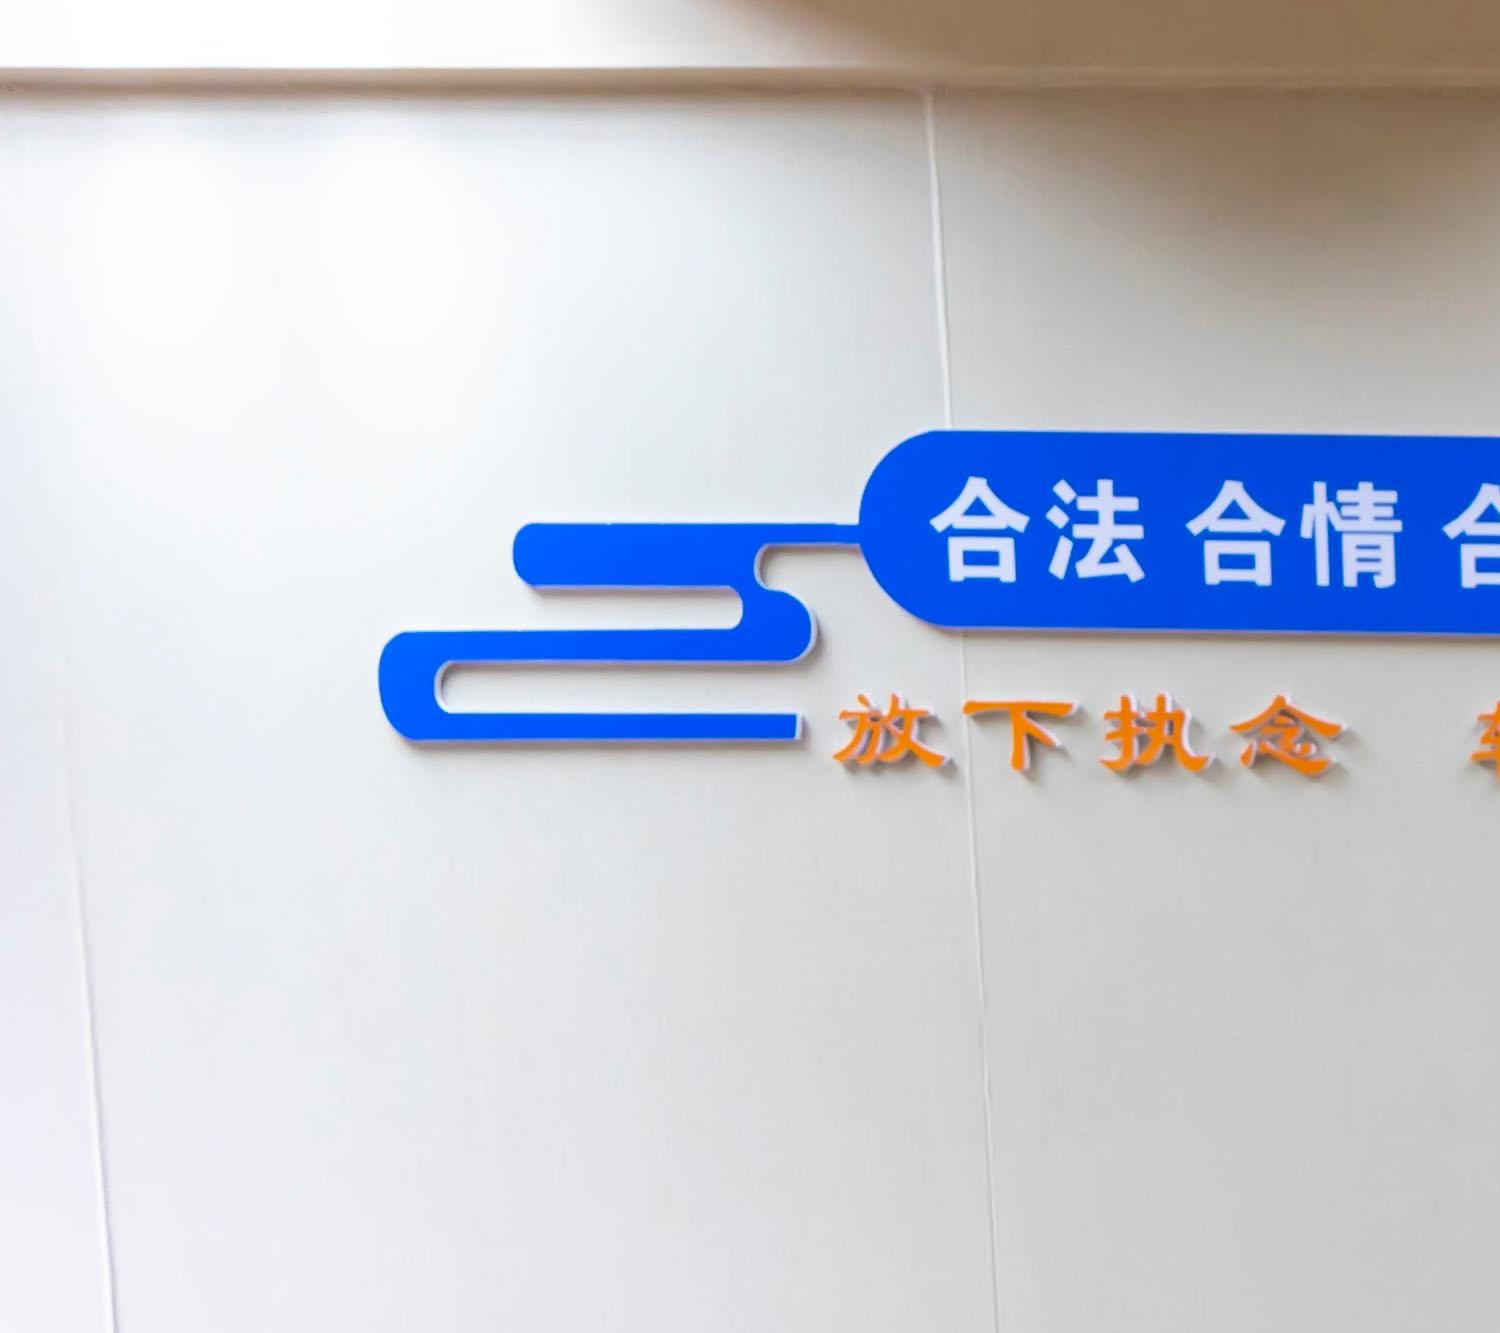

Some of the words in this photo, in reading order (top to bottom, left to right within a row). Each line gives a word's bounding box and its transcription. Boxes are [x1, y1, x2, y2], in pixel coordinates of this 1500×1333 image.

[929, 476, 1146, 585] 合法
[1186, 479, 1403, 590] 合情
[831, 692, 1349, 776] 放下执念
